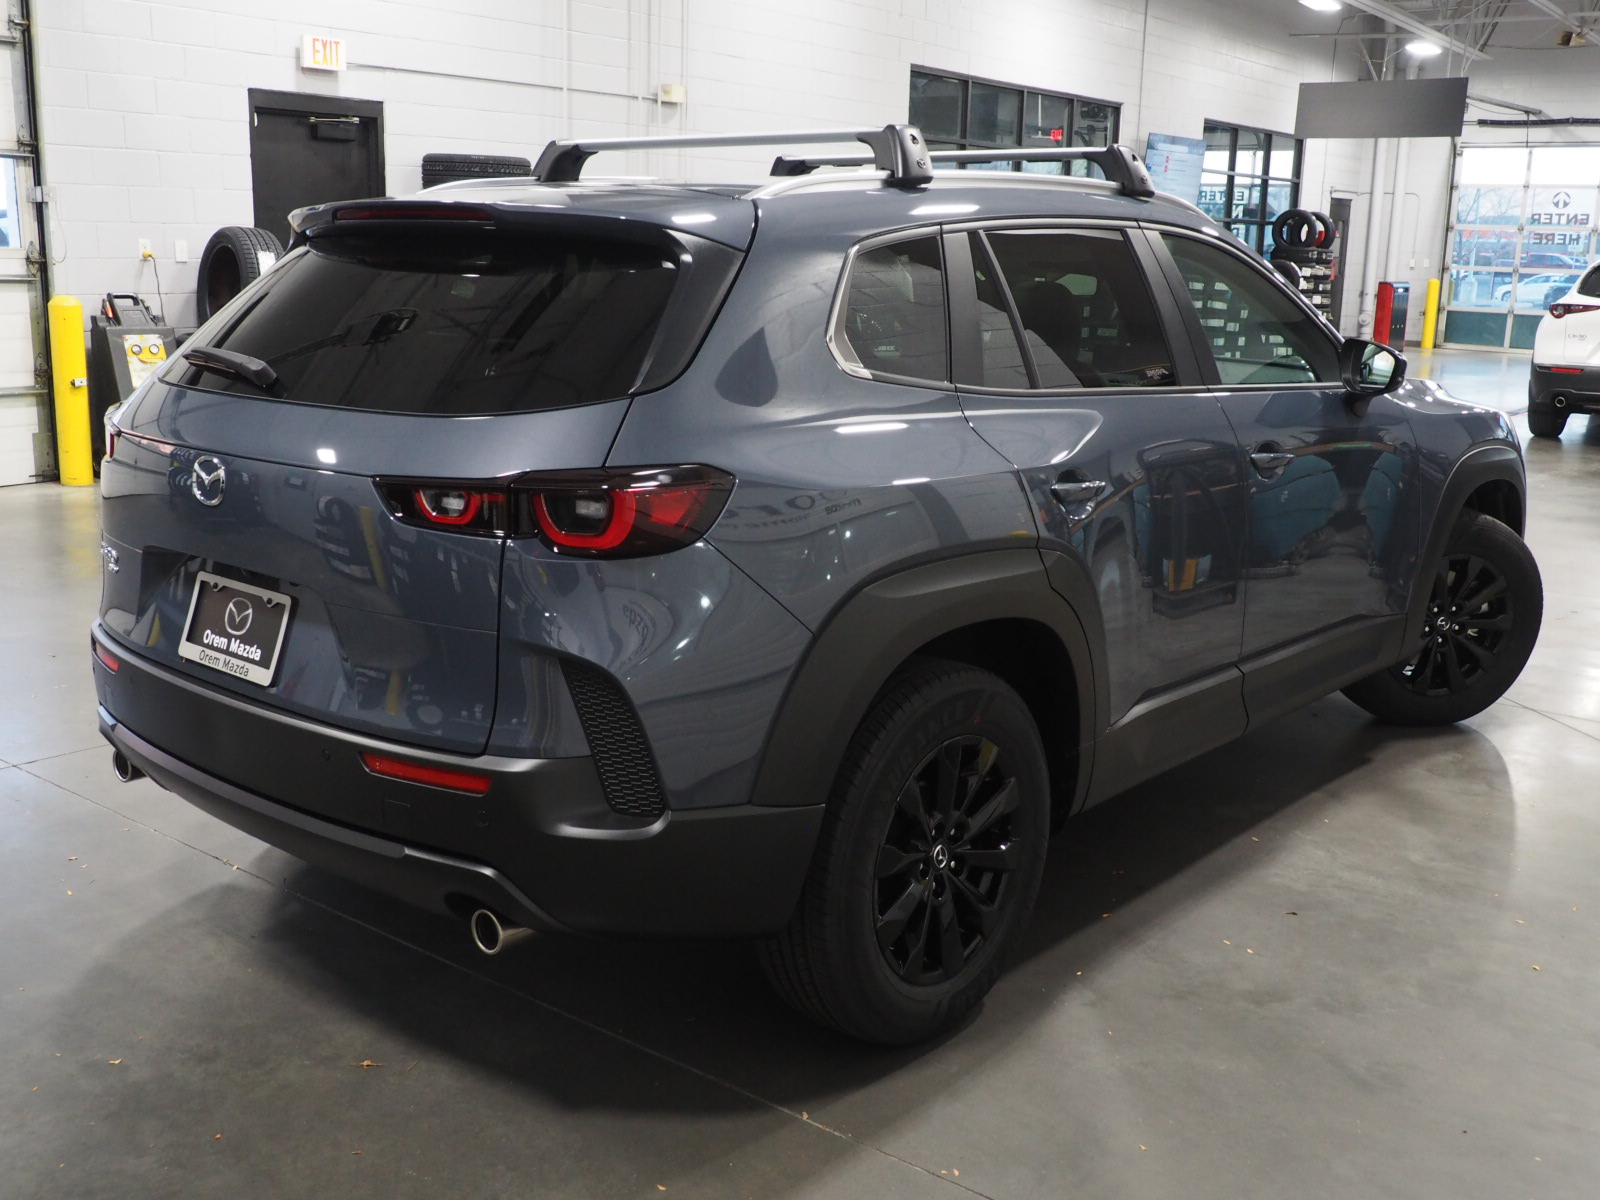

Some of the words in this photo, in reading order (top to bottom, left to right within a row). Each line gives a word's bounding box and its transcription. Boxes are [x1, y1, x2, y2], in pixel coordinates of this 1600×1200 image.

[312, 38, 341, 67] EXIT
[203, 629, 227, 649] Orem
[229, 638, 261, 661] Mazda
[199, 649, 220, 667] Orem
[222, 657, 249, 677] Mazda
